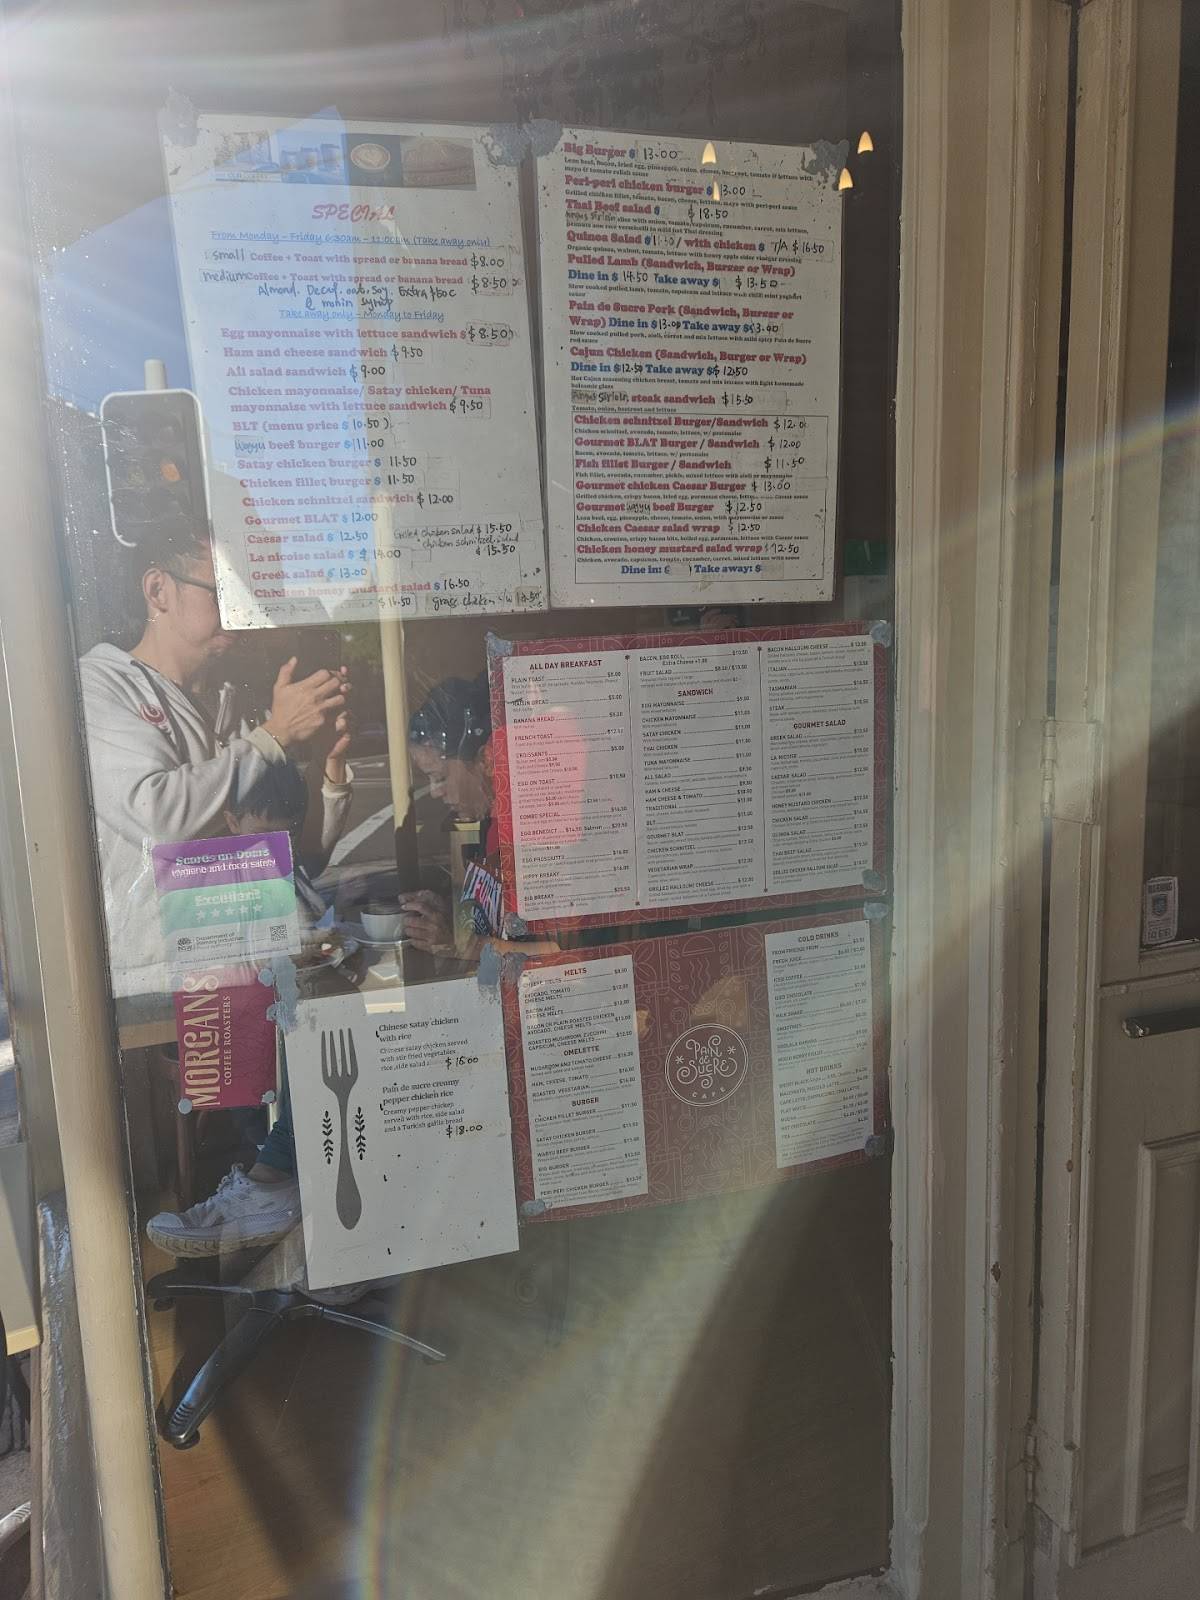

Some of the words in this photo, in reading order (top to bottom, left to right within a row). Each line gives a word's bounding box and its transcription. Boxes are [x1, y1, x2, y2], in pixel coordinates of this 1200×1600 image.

[564, 143, 584, 154] Big
[586, 144, 627, 158] Burger
[565, 175, 616, 189] Peri-peri
[666, 182, 705, 195] burger
[566, 199, 592, 209] Thai
[594, 200, 620, 211] Beef
[567, 230, 608, 242] Quinoa
[611, 231, 642, 244] Salad
[713, 240, 757, 250] chicken
[250, 252, 283, 262] Coffee
[294, 253, 322, 262] Toast
[353, 255, 386, 265] spread
[440, 257, 468, 266] bread
[471, 253, 504, 269] $8.00
[568, 254, 605, 265] Pulled
[607, 255, 638, 266] Lamb
[641, 257, 705, 272] (Sandwich,
[568, 269, 594, 280] Dine
[654, 272, 678, 284] Take
[680, 275, 709, 287] away
[568, 300, 594, 310] Pain
[597, 301, 610, 311] de
[613, 302, 645, 312] Sucre
[648, 304, 676, 314] Pork
[364, 310, 401, 322] Monday
[608, 317, 635, 327] Dine
[220, 328, 245, 340] Egg
[248, 329, 320, 339] mayonnaise
[357, 329, 398, 339] lettuce
[401, 329, 457, 339] sandwich
[223, 347, 254, 357] Ham
[284, 348, 325, 357] cheese
[328, 347, 388, 358] sandwich
[391, 345, 423, 362] $9.50
[570, 346, 604, 358] Cajun
[607, 347, 652, 358] Chicken
[773, 353, 807, 365] Wrap)
[226, 366, 246, 377] All
[367, 386, 402, 397] Satay
[460, 386, 491, 395] Tuna
[631, 394, 661, 404] steak
[664, 395, 716, 405] sandwich
[389, 401, 447, 410] sandwich
[232, 421, 258, 431] BLT
[307, 420, 338, 432] price
[623, 416, 672, 426] schnitzel
[575, 437, 625, 447] Gourmet
[627, 438, 658, 447] BLAT
[707, 439, 760, 449] Sandwich
[237, 459, 273, 470] Satay
[276, 458, 325, 468] chicken
[328, 459, 370, 470] burger
[575, 459, 599, 468] Fish
[602, 459, 628, 469] fillet
[630, 459, 669, 470] Burger
[240, 478, 292, 488] Chicken
[296, 478, 324, 487] fillet
[672, 481, 708, 490] Caesar
[298, 495, 352, 505] schnitzel
[652, 502, 675, 511] beef
[244, 514, 301, 527] Gourmet
[304, 513, 338, 523] BLAT
[576, 523, 621, 533] Chicken
[691, 524, 721, 533] wrap
[247, 534, 289, 544] Caesar
[292, 533, 325, 543] salad
[624, 544, 657, 555] honey
[659, 544, 703, 553] mustard
[705, 544, 733, 553] salad
[620, 564, 646, 574] Dine
[721, 564, 753, 574] away:
[251, 570, 289, 580] Greek
[545, 662, 559, 670] DAY
[560, 659, 603, 669] BREAKFAST
[677, 688, 713, 697] SANDWICH
[793, 721, 825, 730] GOURMET
[825, 719, 846, 727] SALAD
[176, 855, 214, 867] Scores
[815, 931, 839, 940] DRINKS
[564, 967, 587, 976] MELTS
[223, 995, 232, 1047] ROASTERS
[379, 1022, 408, 1032] Chinese
[410, 1019, 430, 1029] satay
[431, 1017, 459, 1026] chicken
[183, 975, 220, 1106] MORGANS
[380, 1034, 396, 1042] with
[398, 1033, 412, 1041] rice
[563, 1045, 600, 1056] OMELETTE
[223, 1048, 232, 1086] COFFEE
[382, 1085, 399, 1094] Pain
[411, 1082, 431, 1090] sucre
[432, 1079, 460, 1088] creamy
[383, 1095, 409, 1106] pepper
[411, 1092, 439, 1101] chicken
[571, 1097, 599, 1107] BURGER
[383, 1106, 407, 1116] Creamy
